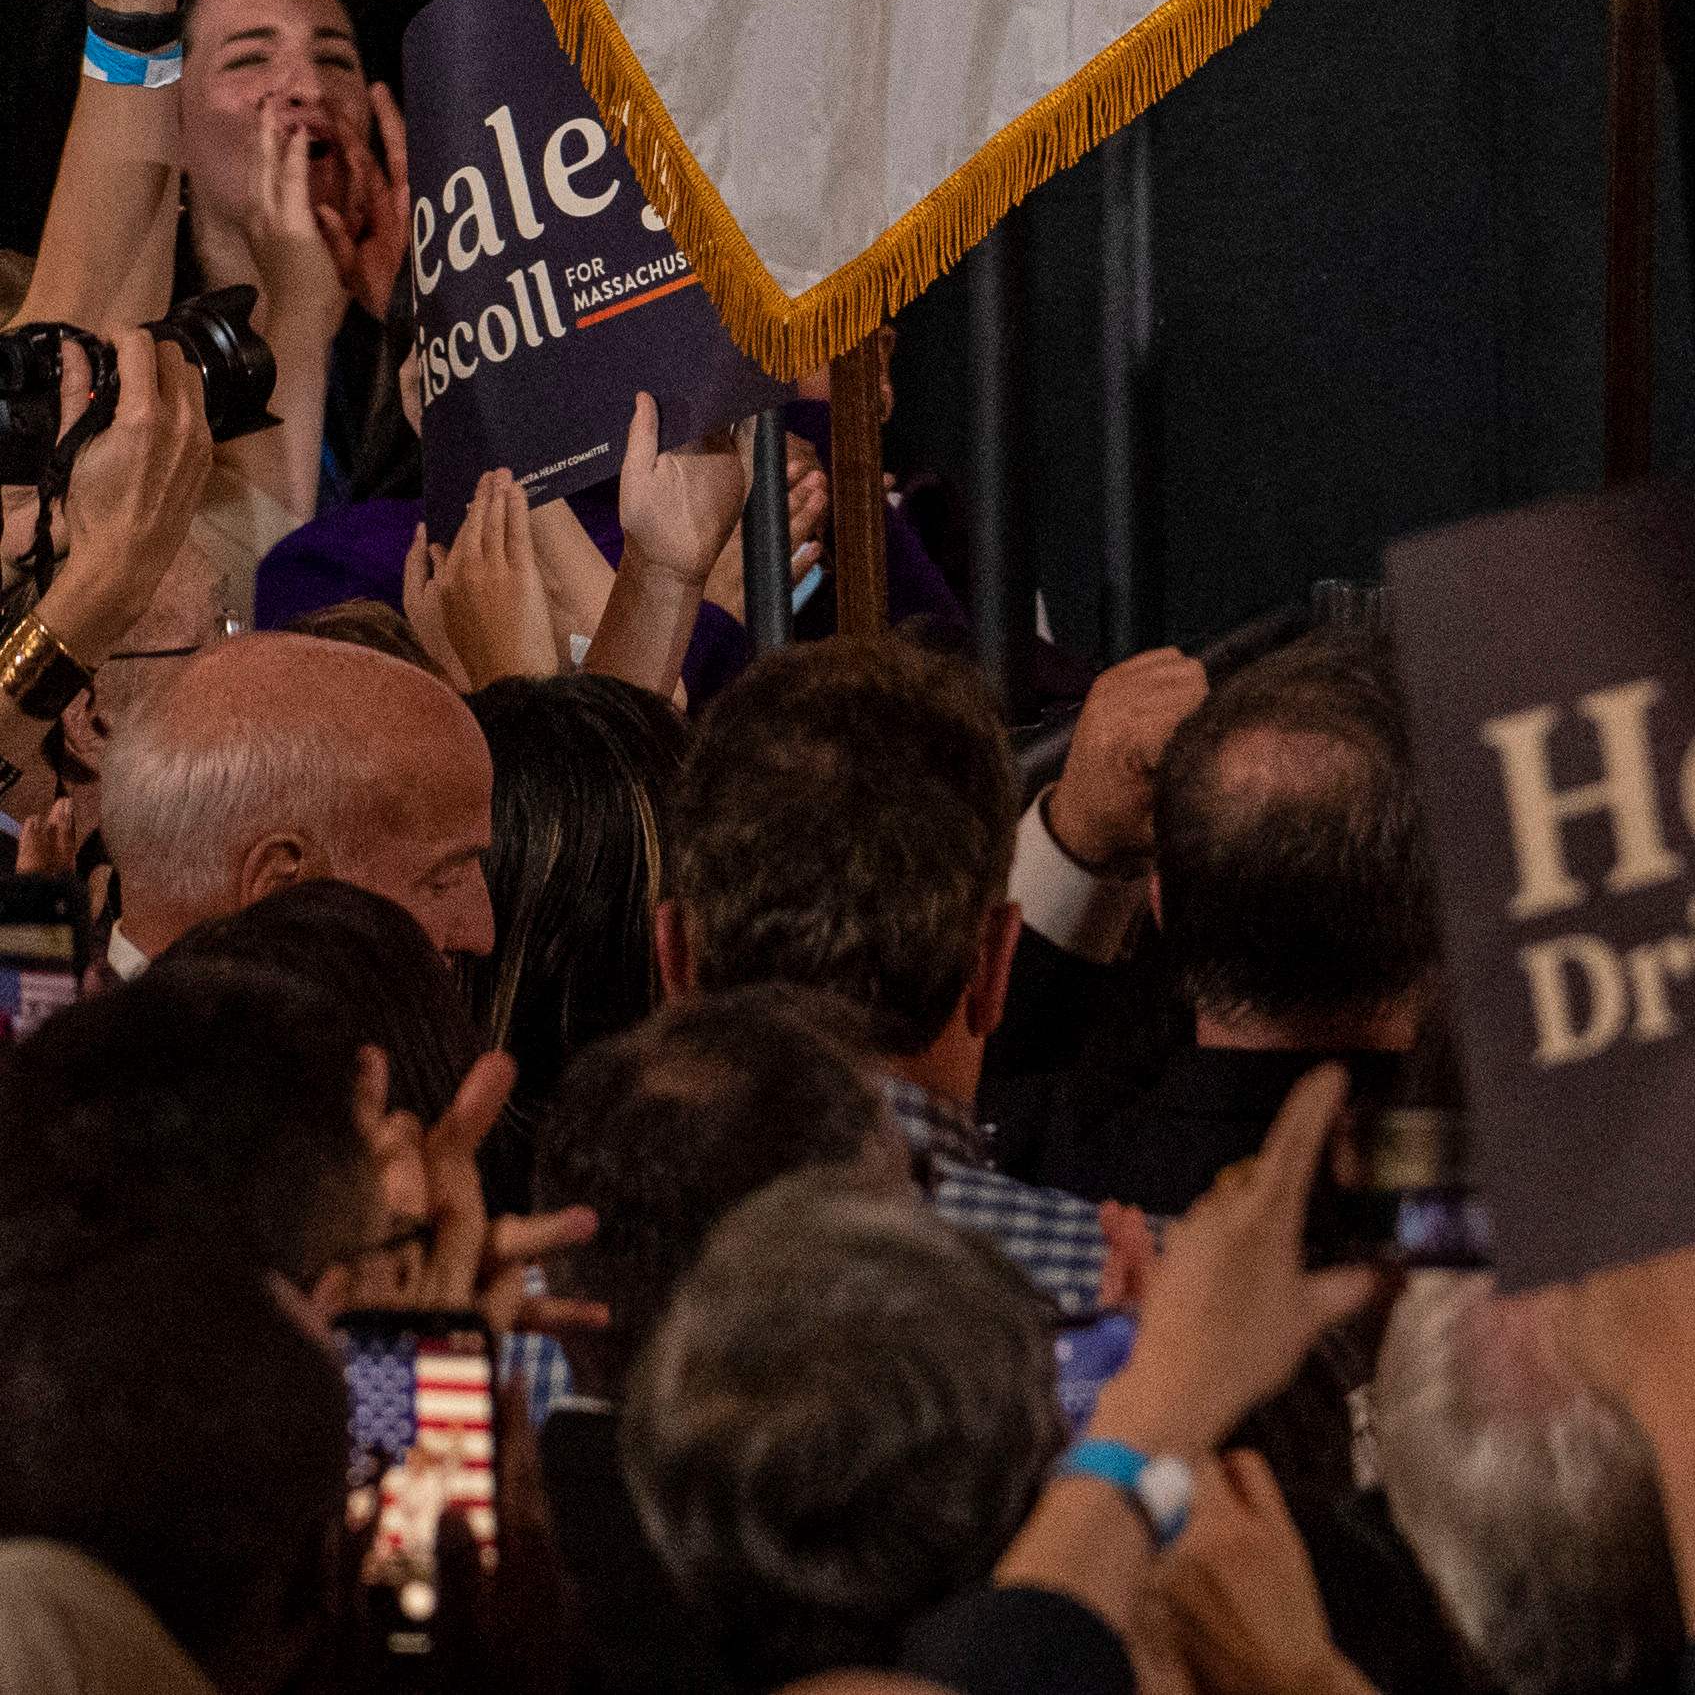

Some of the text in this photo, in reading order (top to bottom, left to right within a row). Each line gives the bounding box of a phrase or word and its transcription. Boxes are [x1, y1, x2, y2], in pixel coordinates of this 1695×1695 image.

[413, 102, 676, 296] eale
[565, 257, 606, 288] FOR
[573, 250, 693, 312] MASSACHUS
[418, 259, 568, 408] iscoll
